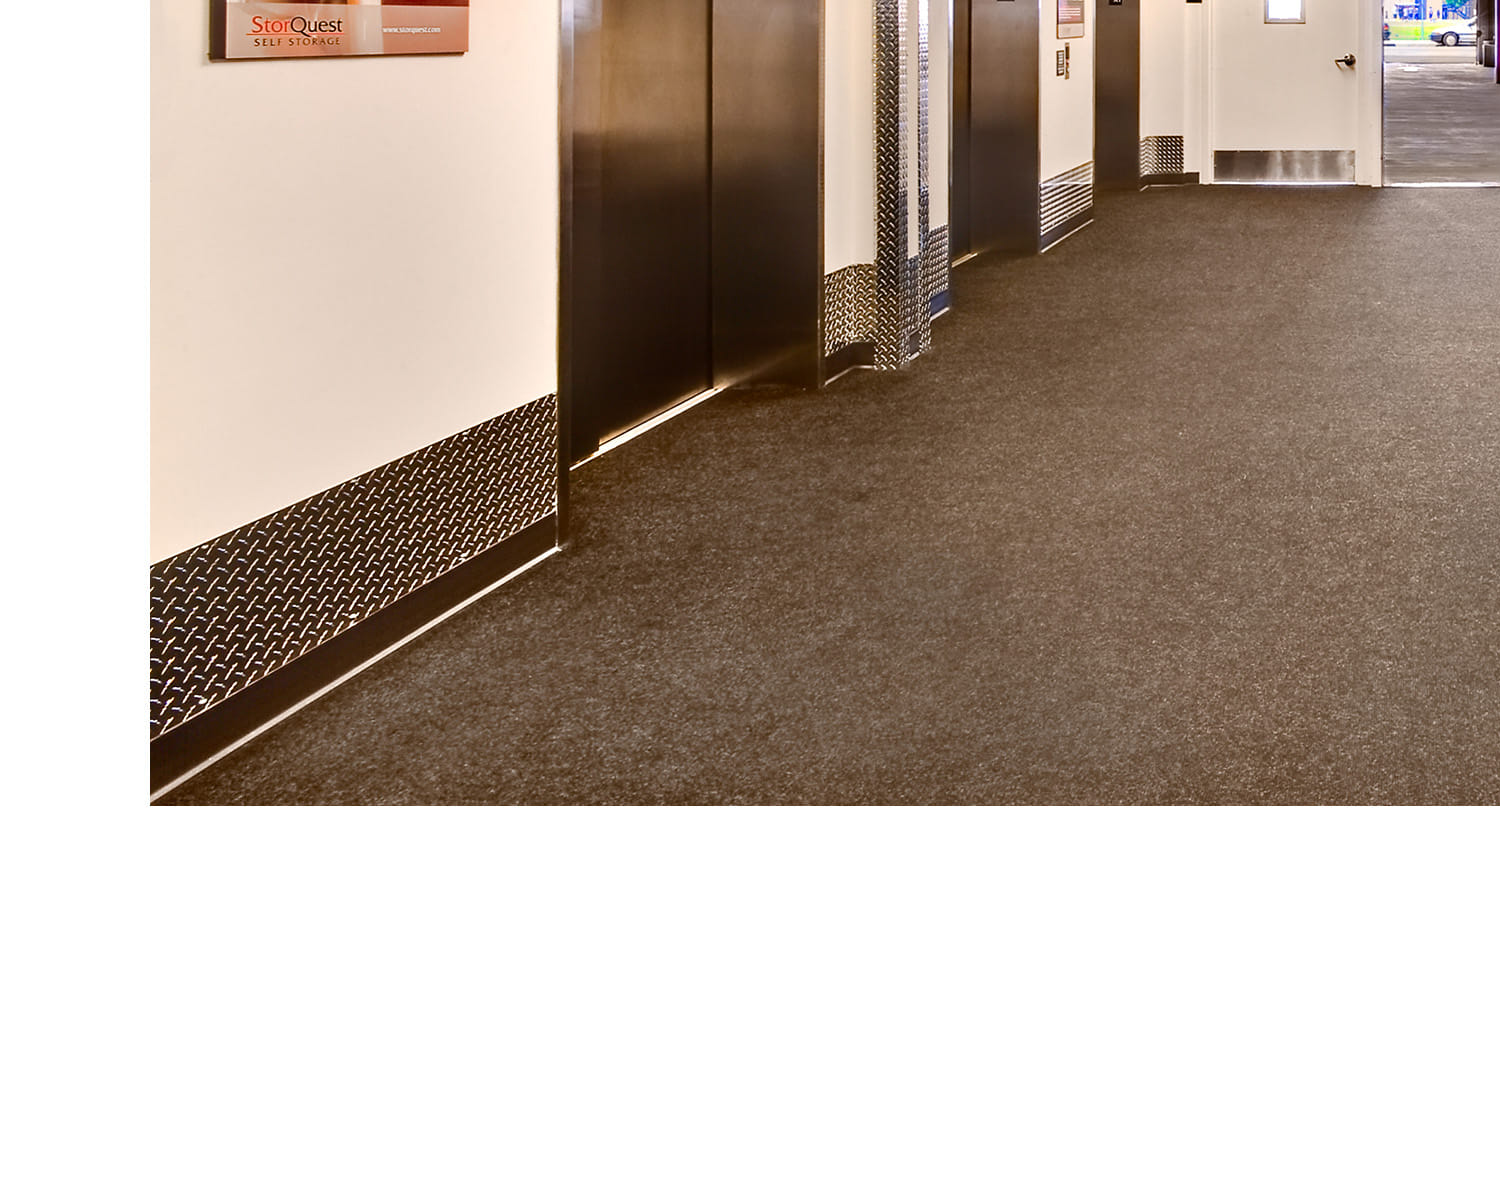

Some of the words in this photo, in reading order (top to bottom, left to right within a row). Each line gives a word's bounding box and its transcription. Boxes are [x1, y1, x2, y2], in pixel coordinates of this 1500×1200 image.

[251, 15, 343, 37] StorQuest
[254, 38, 281, 47] SELF
[288, 37, 341, 47] STORAGE
